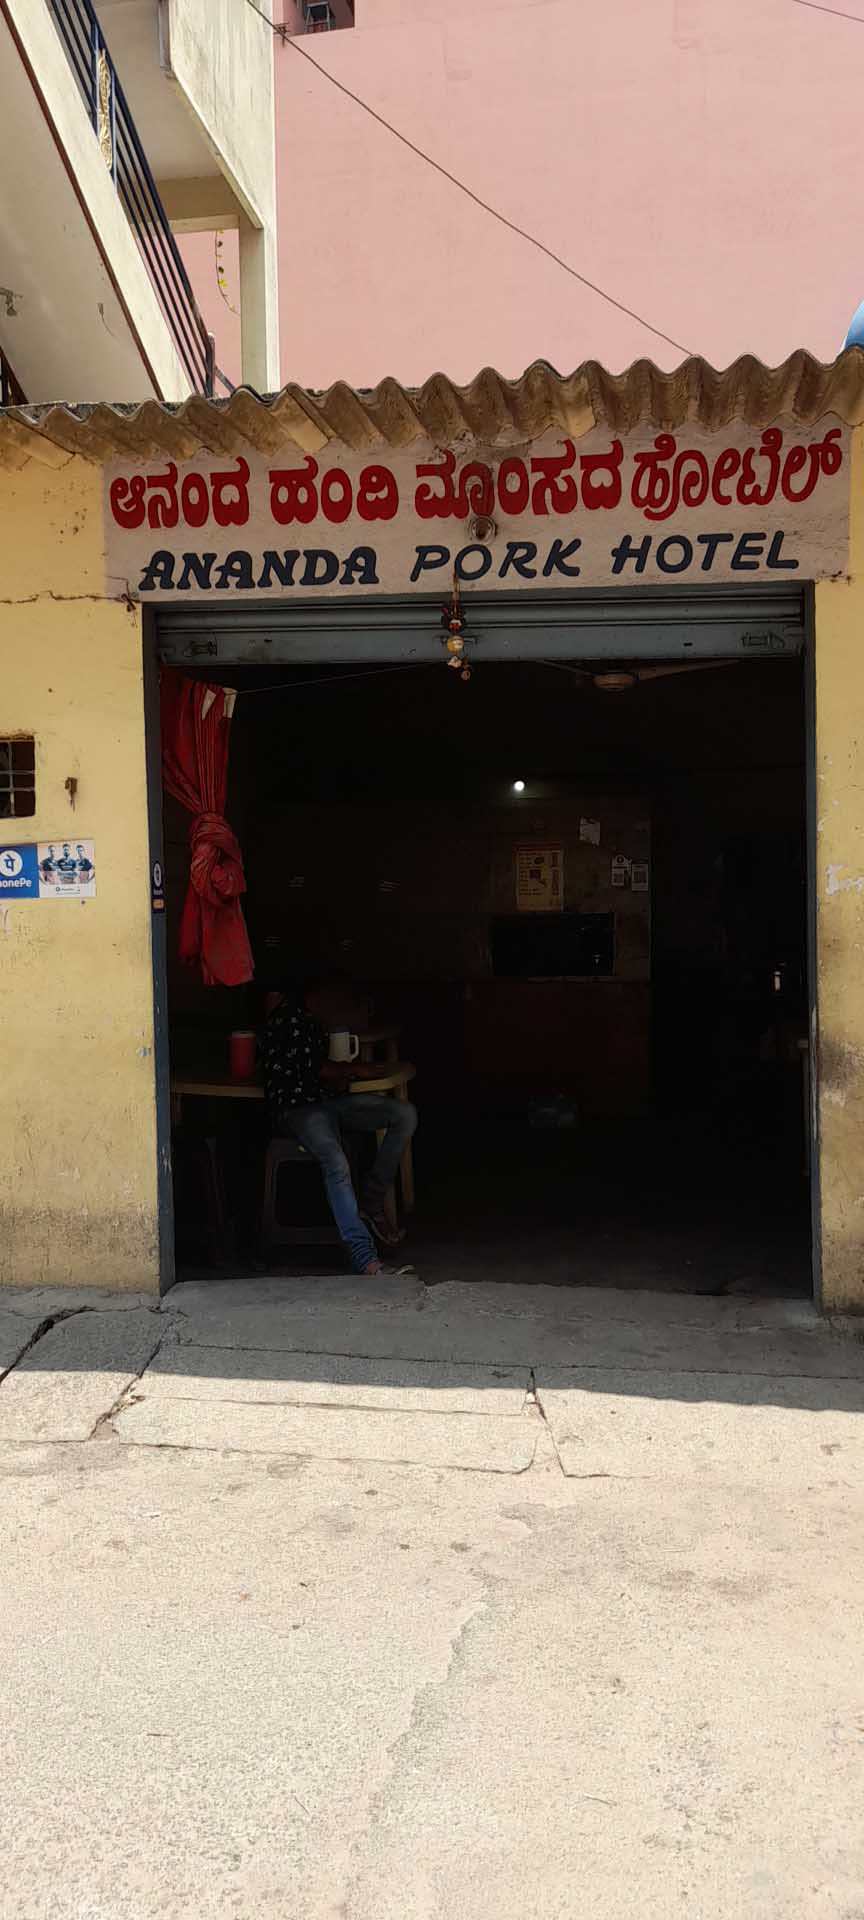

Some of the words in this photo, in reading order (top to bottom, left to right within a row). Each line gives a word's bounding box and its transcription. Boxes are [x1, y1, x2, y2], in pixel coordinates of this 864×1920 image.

[110, 456, 250, 530] ಆನಂದ
[268, 455, 399, 525] ಹಂದಿ
[414, 439, 624, 520] ಮಾಂಸದ
[630, 427, 842, 521] ಹೋಟೆಲ್
[138, 546, 379, 591] ANANDA
[410, 539, 582, 582] PORK
[611, 530, 800, 574] HOTEL
[0, 877, 32, 888] onePe
